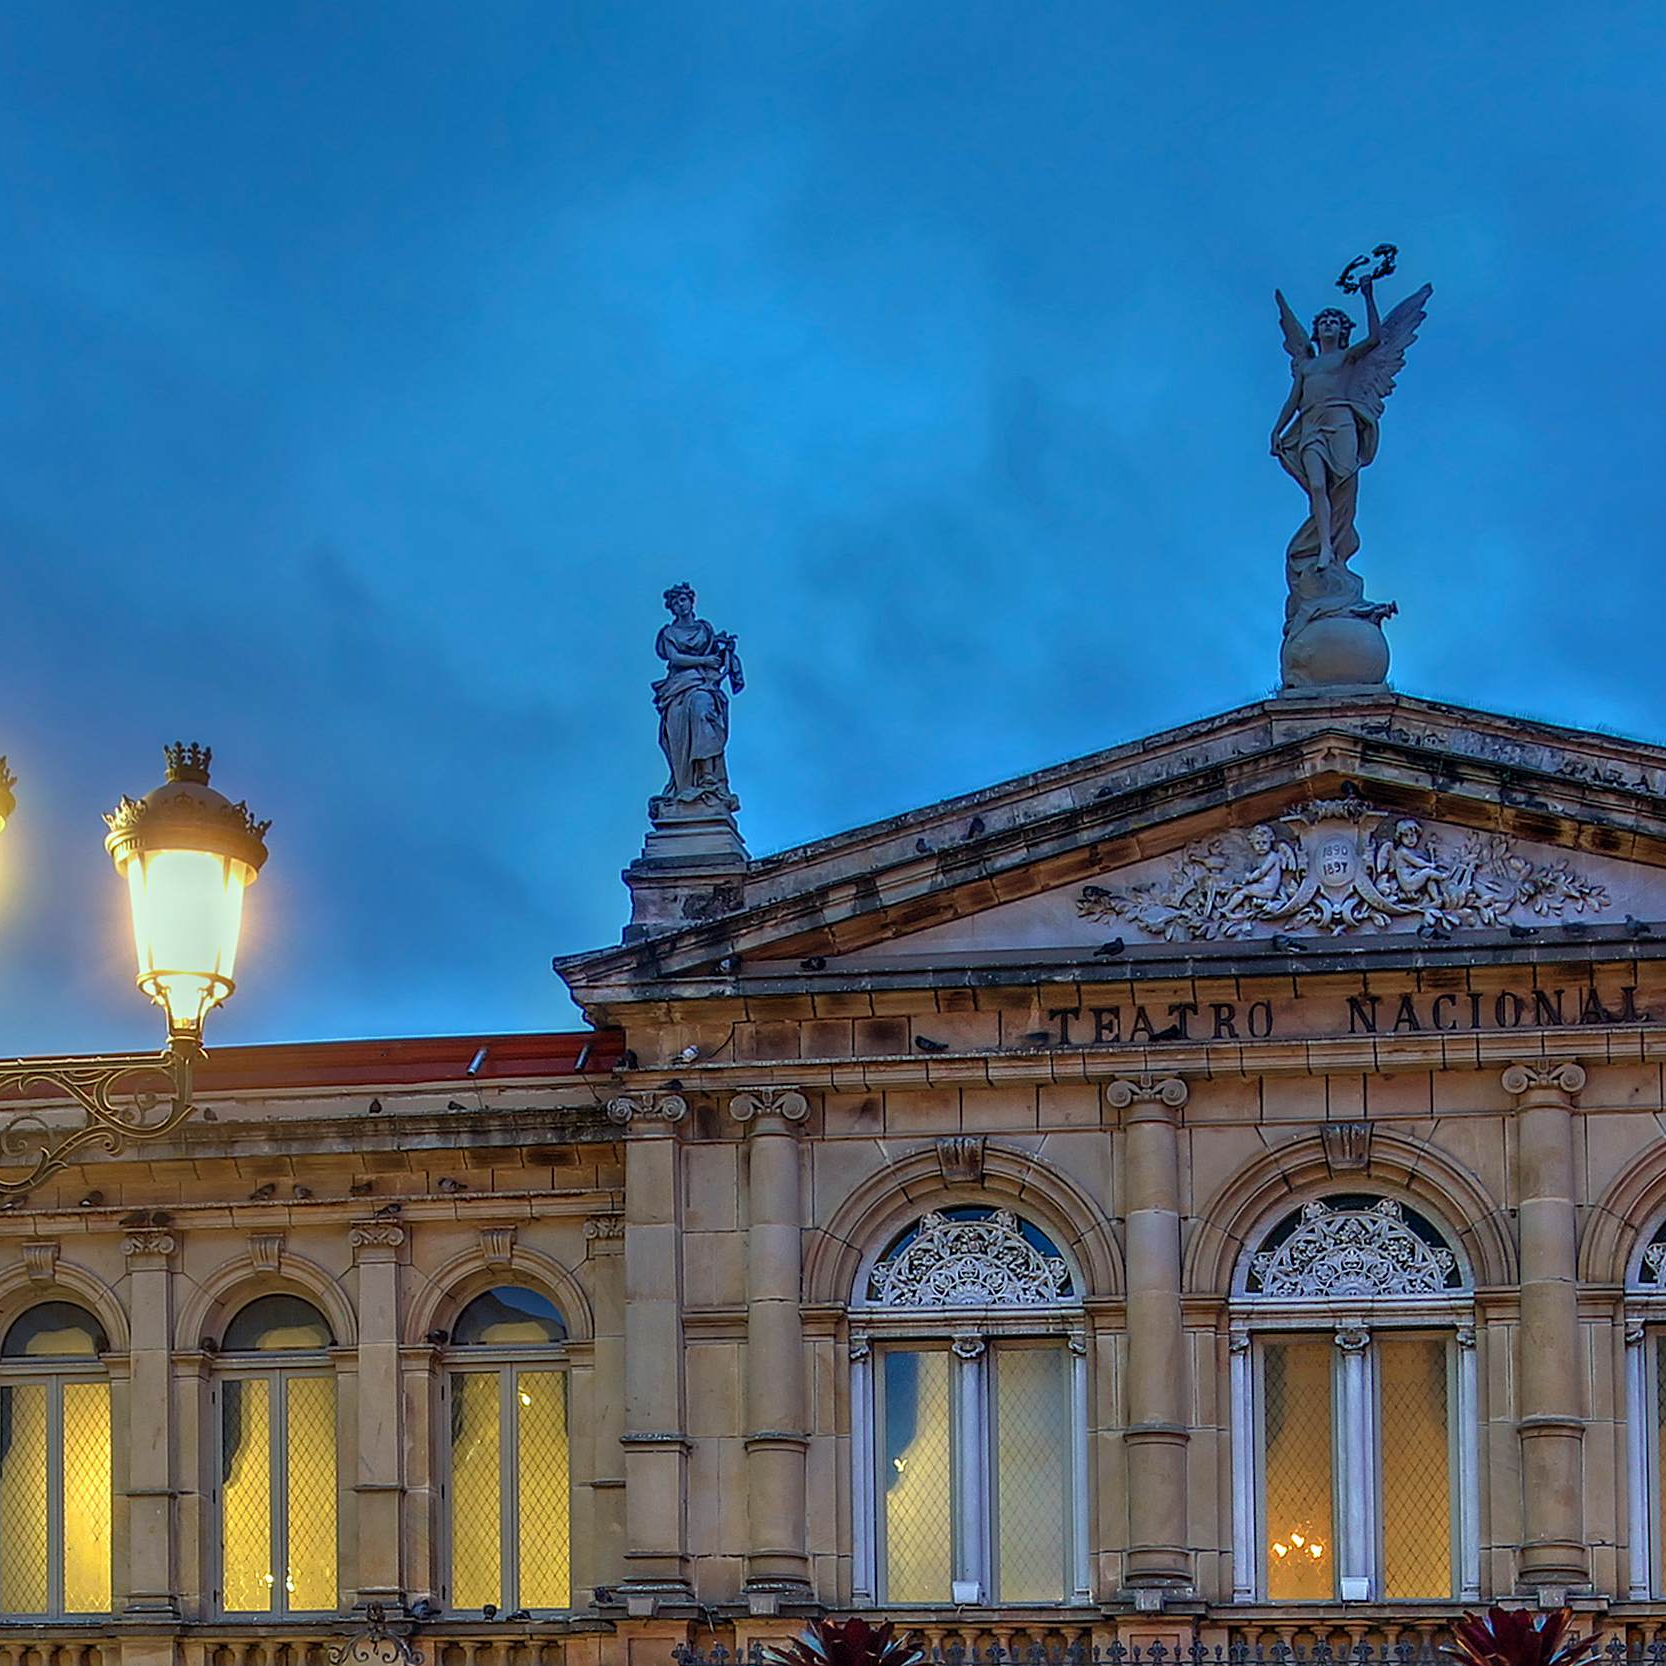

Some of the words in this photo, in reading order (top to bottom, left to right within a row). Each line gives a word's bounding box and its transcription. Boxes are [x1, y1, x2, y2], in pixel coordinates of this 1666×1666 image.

[1323, 844, 1348, 857] 1890
[1323, 861, 1348, 875] 1897
[1048, 1000, 1273, 1046] TEATRO
[1345, 986, 1650, 1034] NACIONAL
